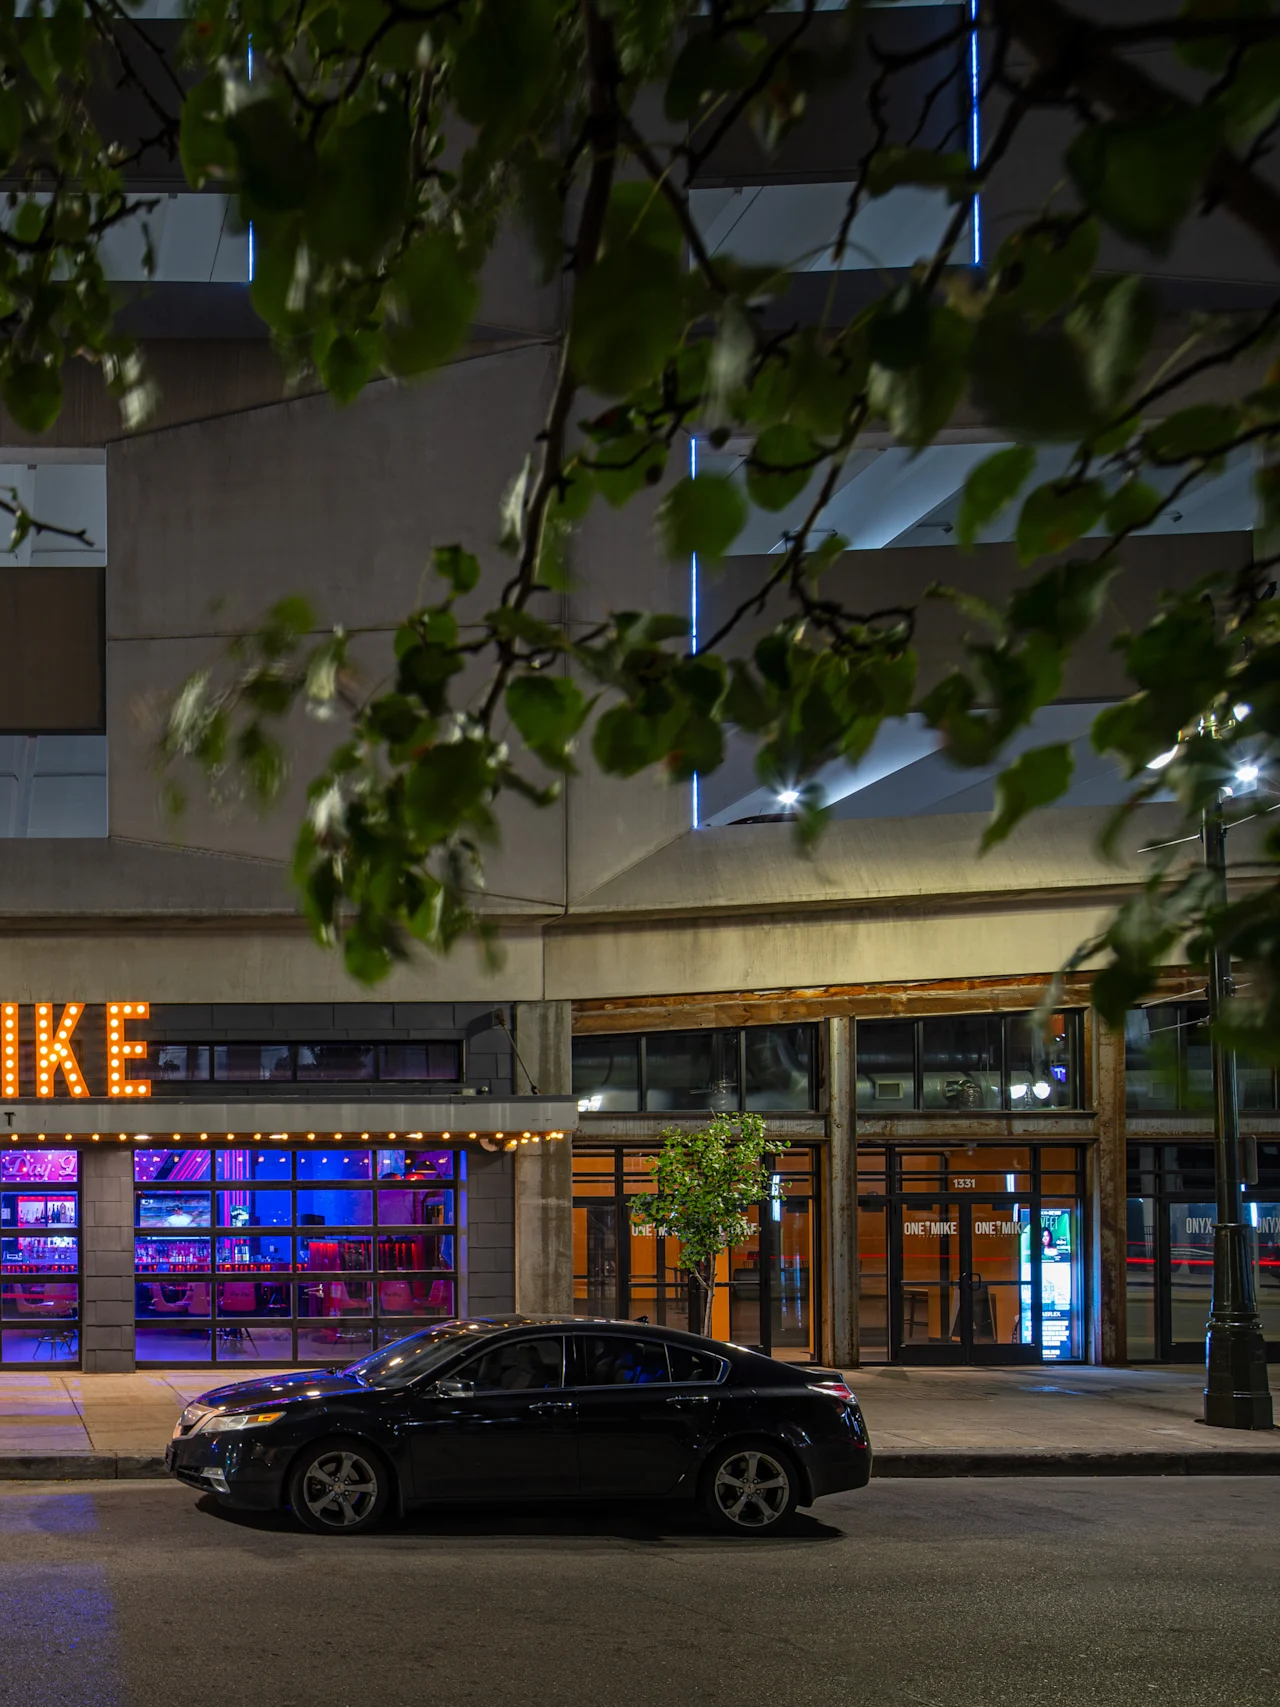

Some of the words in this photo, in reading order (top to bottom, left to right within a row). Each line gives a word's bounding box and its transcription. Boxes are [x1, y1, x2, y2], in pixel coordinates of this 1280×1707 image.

[3, 1154, 52, 1182] Day
[953, 1178, 976, 1188] 1331
[904, 1222, 925, 1235] ONE
[931, 1222, 958, 1235] MIKE
[975, 1222, 996, 1235] ONE
[1002, 1222, 1028, 1235] MIKE
[1186, 1217, 1212, 1233] ONYX
